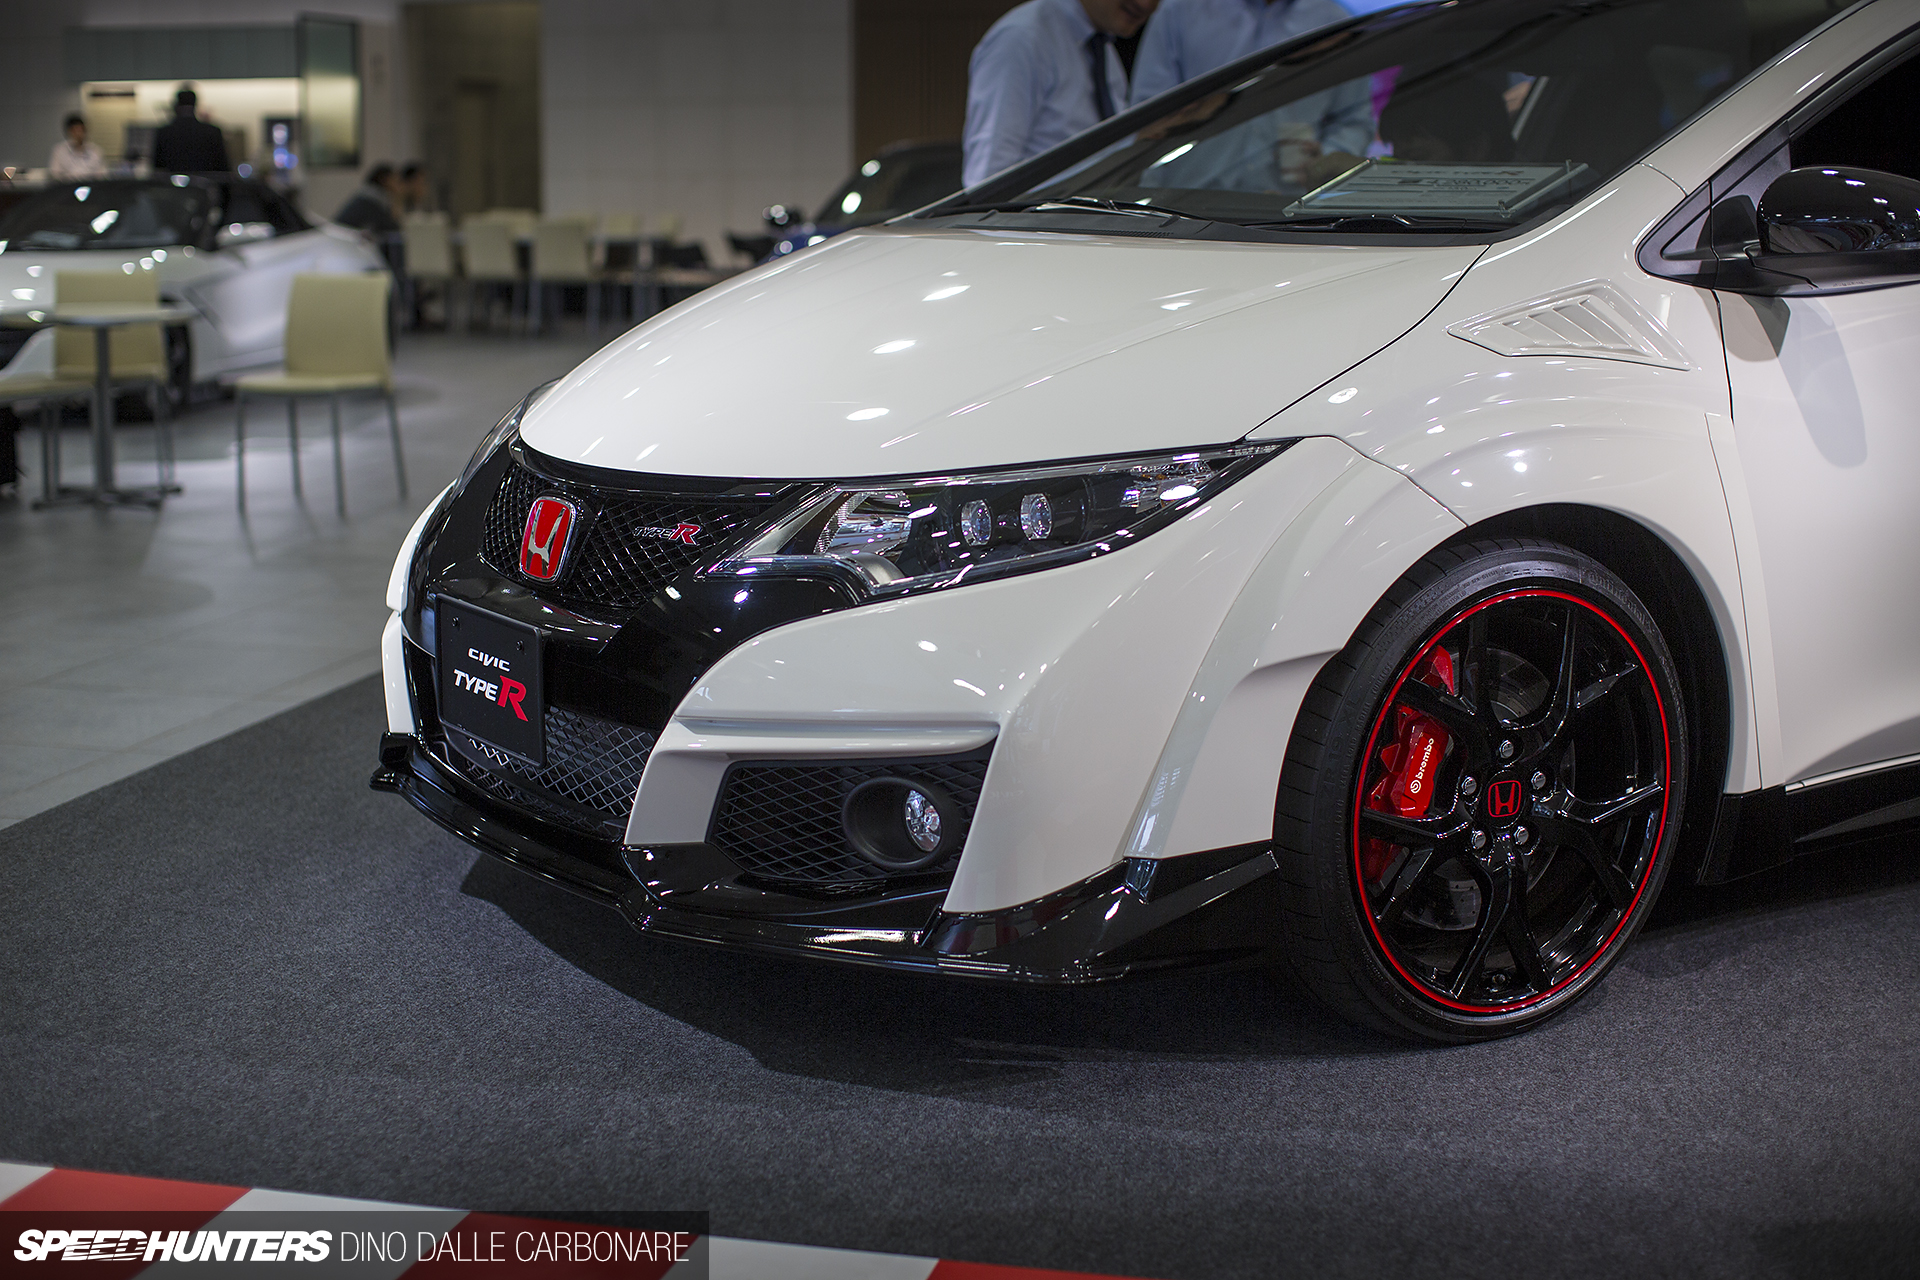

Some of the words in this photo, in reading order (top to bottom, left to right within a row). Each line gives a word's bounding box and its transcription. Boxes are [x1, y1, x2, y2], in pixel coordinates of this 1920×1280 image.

[468, 647, 511, 672] CIVIC
[453, 668, 499, 702] TYPE
[497, 675, 529, 721] R
[1415, 738, 1434, 780] brembo
